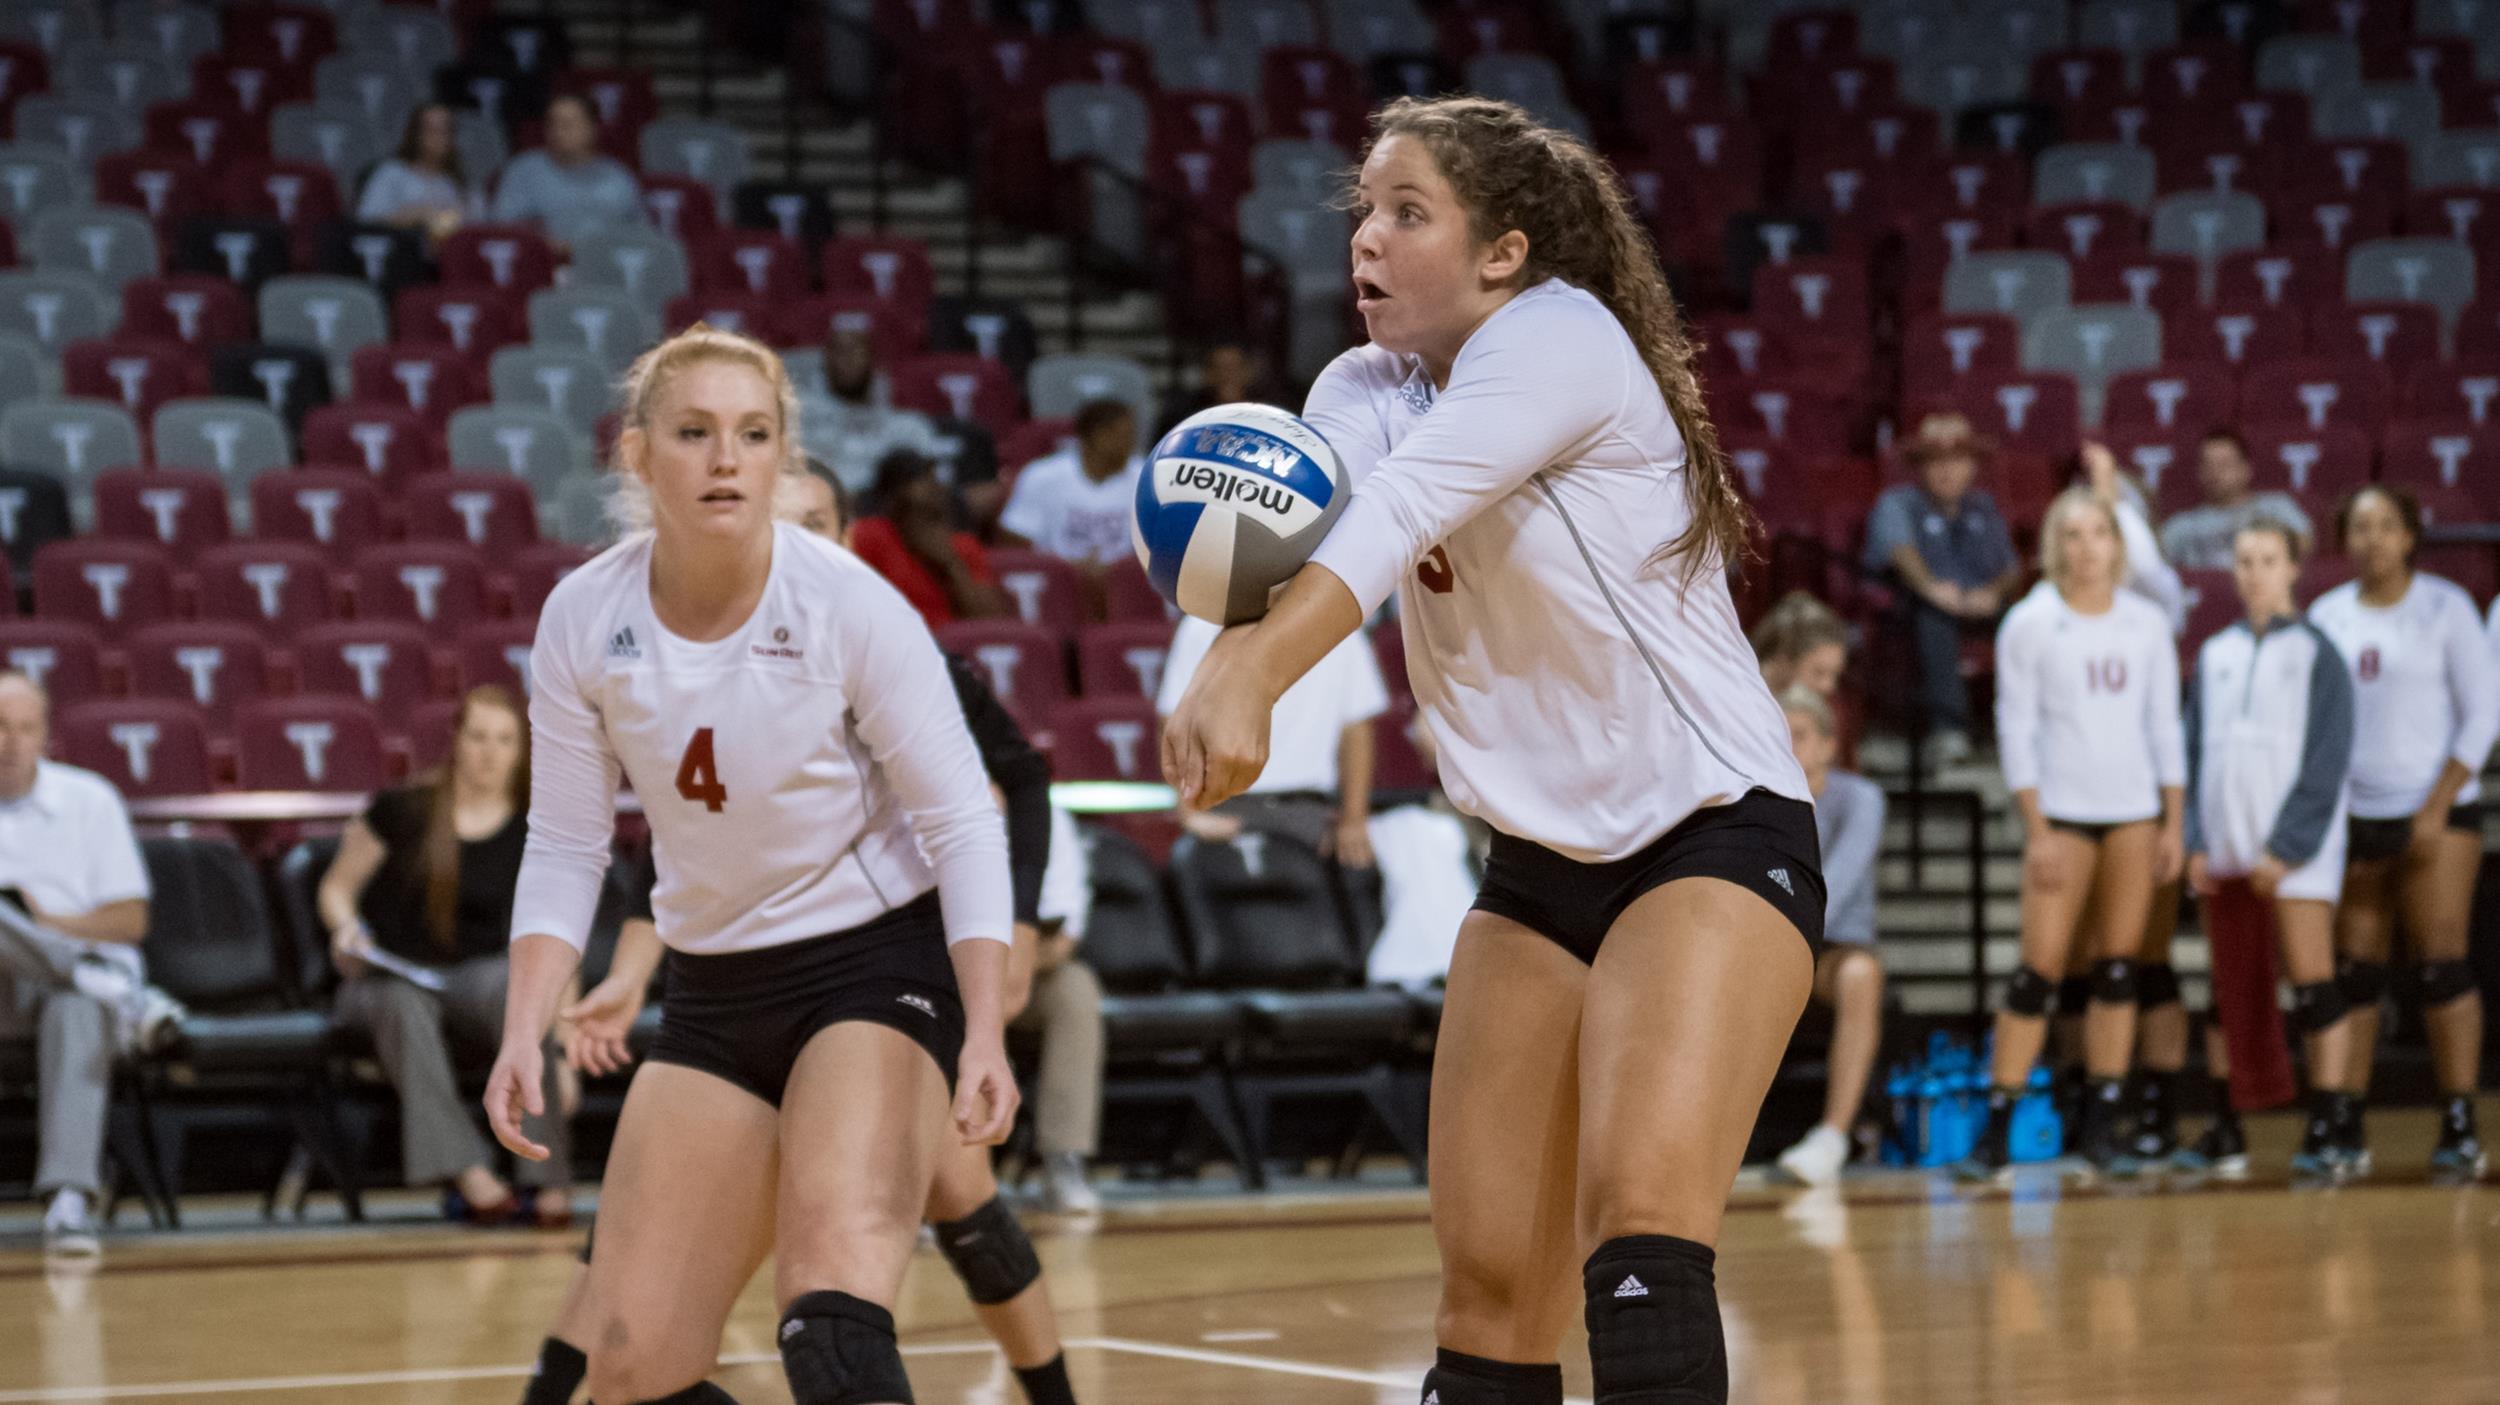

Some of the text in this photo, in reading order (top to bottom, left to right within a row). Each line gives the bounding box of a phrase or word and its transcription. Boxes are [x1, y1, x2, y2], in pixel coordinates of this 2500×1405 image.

[309, 300, 341, 345] T
[440, 303, 478, 352] T
[574, 308, 608, 352] T
[964, 313, 1005, 360] T
[2080, 322, 2110, 362] T
[2218, 314, 2256, 362] T
[2360, 314, 2398, 360] T
[1725, 328, 1762, 372] T
[1943, 327, 1983, 372] T
[108, 358, 148, 408] T
[253, 360, 293, 408] T
[394, 361, 433, 412] T
[537, 366, 570, 412] T
[938, 374, 980, 420] T
[1394, 390, 1432, 414] adida
[2147, 379, 2186, 426] T
[2298, 383, 2338, 430] T
[2461, 377, 2500, 423] T
[1752, 392, 1788, 438] T
[1997, 386, 2035, 430] T
[53, 422, 91, 471] T
[202, 422, 239, 471] T
[351, 424, 391, 474] T
[498, 430, 535, 474] T
[2135, 445, 2175, 490] T
[2281, 442, 2321, 490] T
[2430, 437, 2473, 486] T
[1174, 463, 1295, 515] molten
[1732, 450, 1768, 496] T
[141, 491, 182, 541] T
[298, 491, 339, 541] T
[451, 494, 493, 543] T
[84, 565, 128, 619] T
[243, 564, 287, 618] T
[400, 567, 444, 619] T
[1006, 574, 1044, 620] T
[177, 649, 222, 702] T
[343, 645, 389, 699] T
[978, 646, 1018, 697] T
[2088, 659, 2127, 694] 10
[109, 724, 158, 782] T
[285, 724, 334, 780] T
[675, 727, 727, 813] 4
[1099, 723, 1142, 776] T
[1614, 1285, 1649, 1297] adidas
